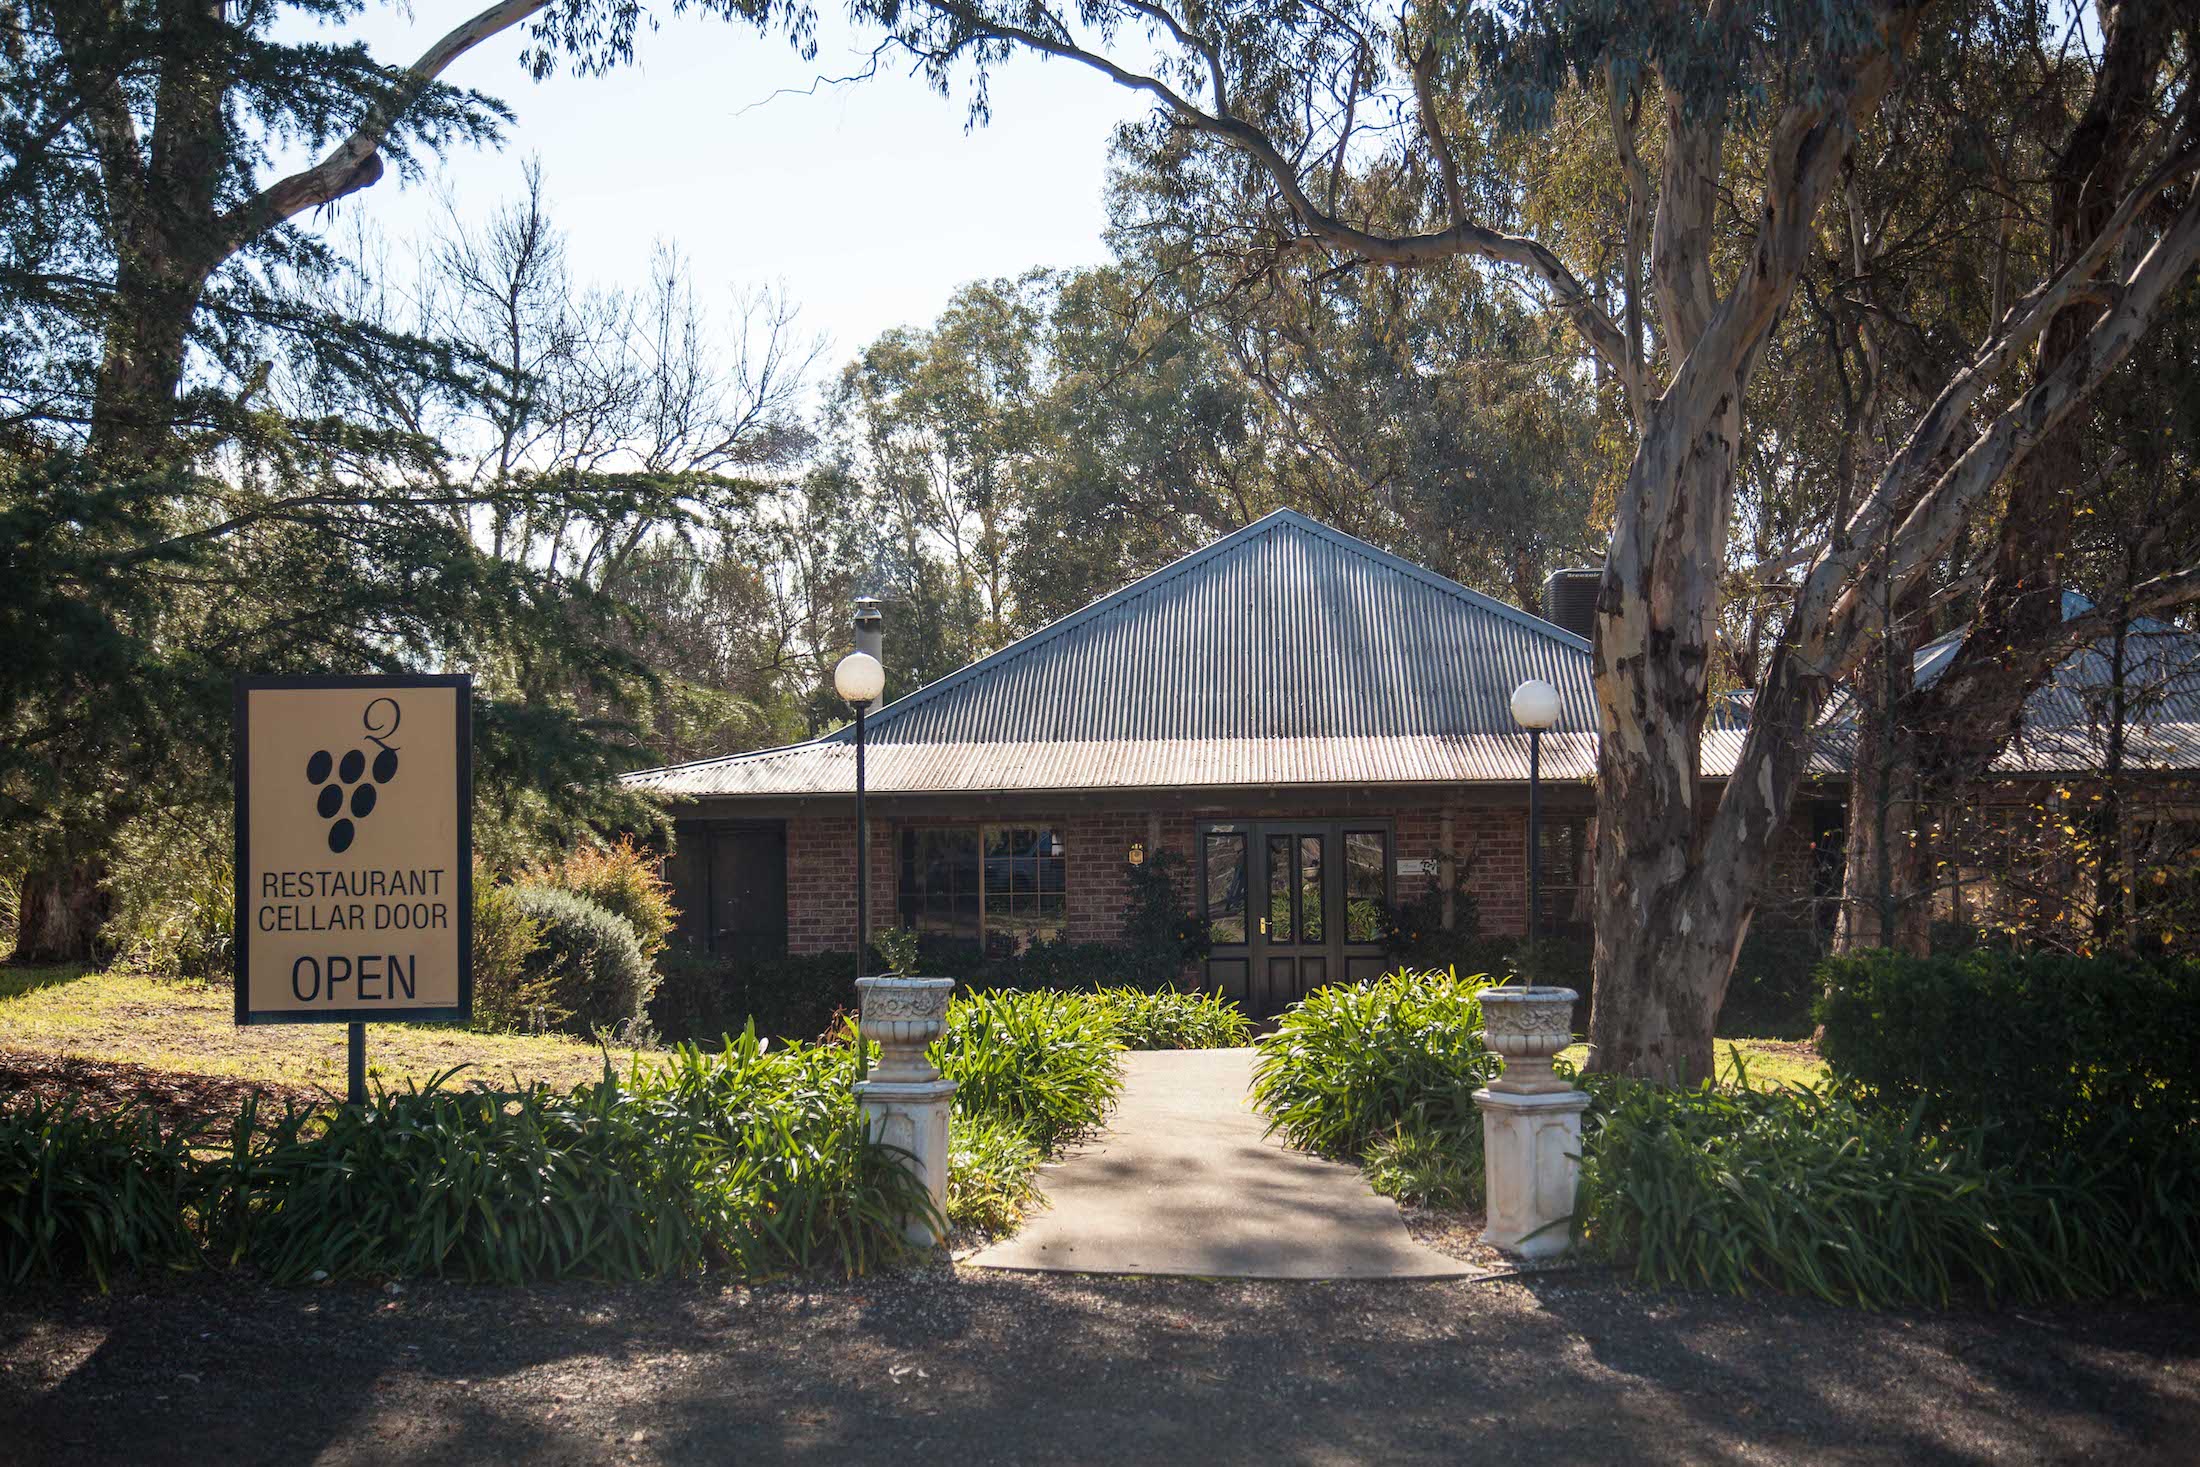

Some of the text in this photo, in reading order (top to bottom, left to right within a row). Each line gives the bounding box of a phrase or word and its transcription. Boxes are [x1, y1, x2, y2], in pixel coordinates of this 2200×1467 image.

[262, 869, 445, 899] RESTAURANT
[258, 903, 448, 932] CELLAR DOOR
[291, 954, 416, 1001] OPEN
